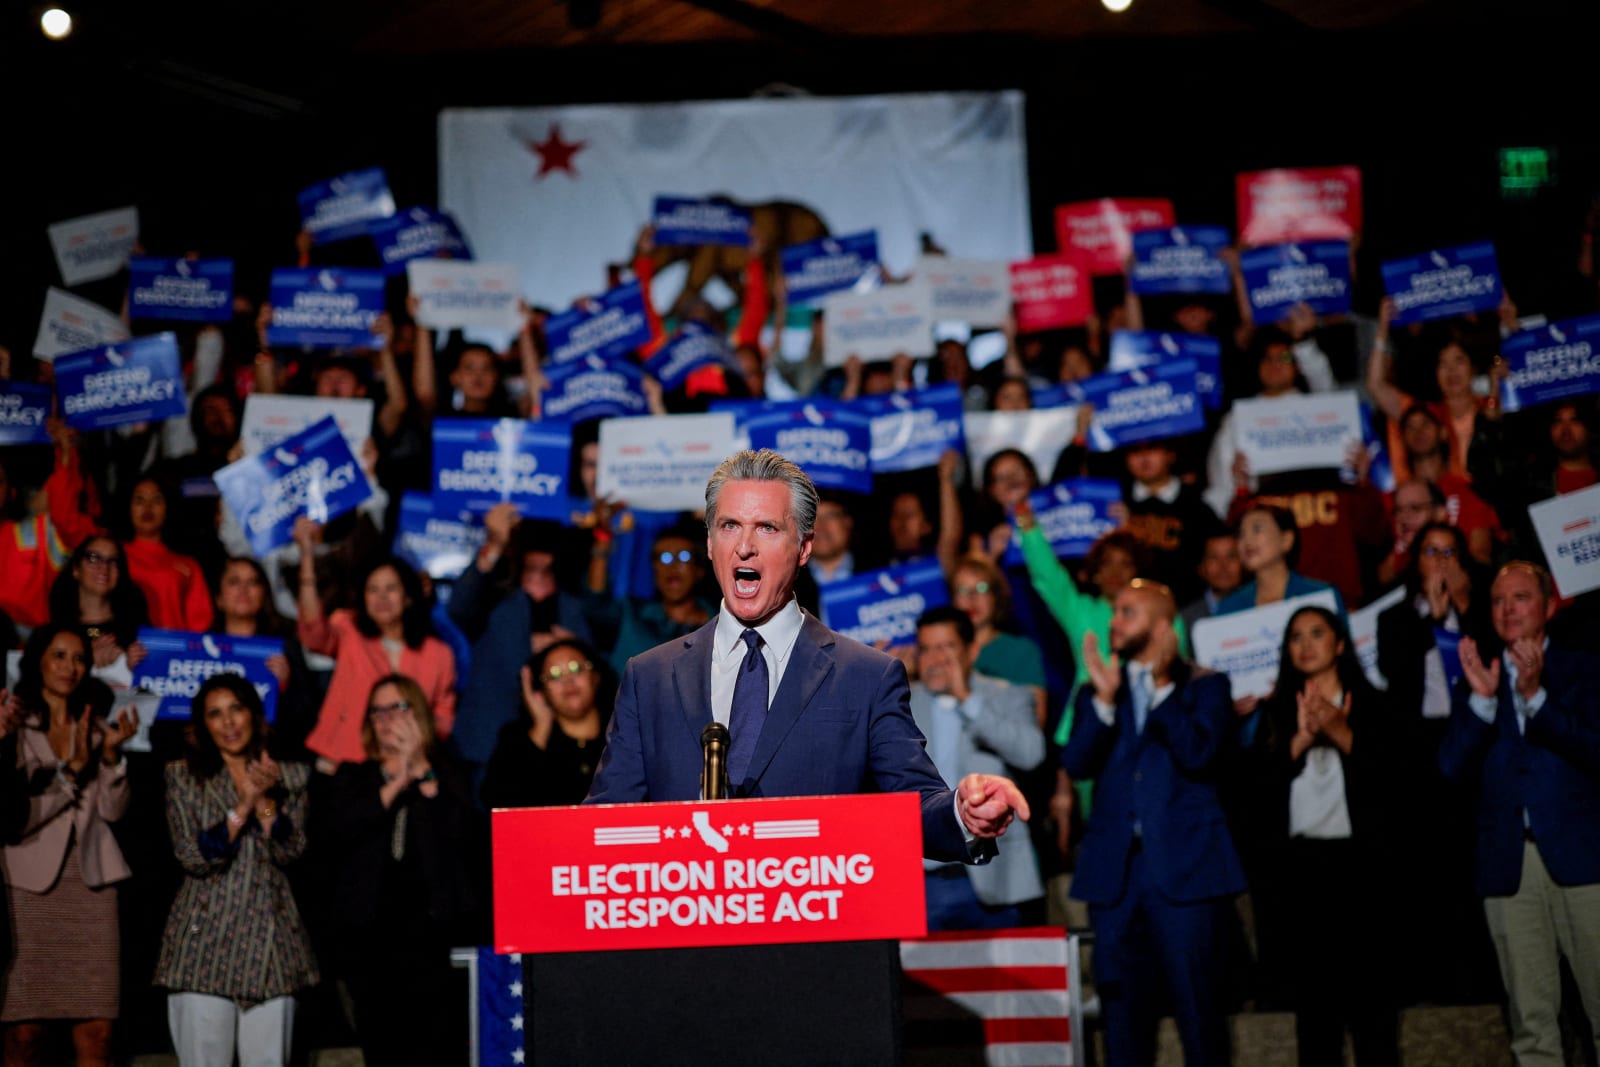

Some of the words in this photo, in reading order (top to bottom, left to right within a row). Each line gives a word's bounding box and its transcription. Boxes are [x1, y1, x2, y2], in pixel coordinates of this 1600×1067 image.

[1525, 341, 1591, 366] DEFEND
[65, 380, 175, 414] DEMOCRACY
[84, 367, 150, 393] DEFEND
[552, 860, 714, 896] ELECTION
[724, 854, 874, 890] RIGGING
[585, 897, 764, 930] RESPONSE
[773, 890, 842, 922] ACT
